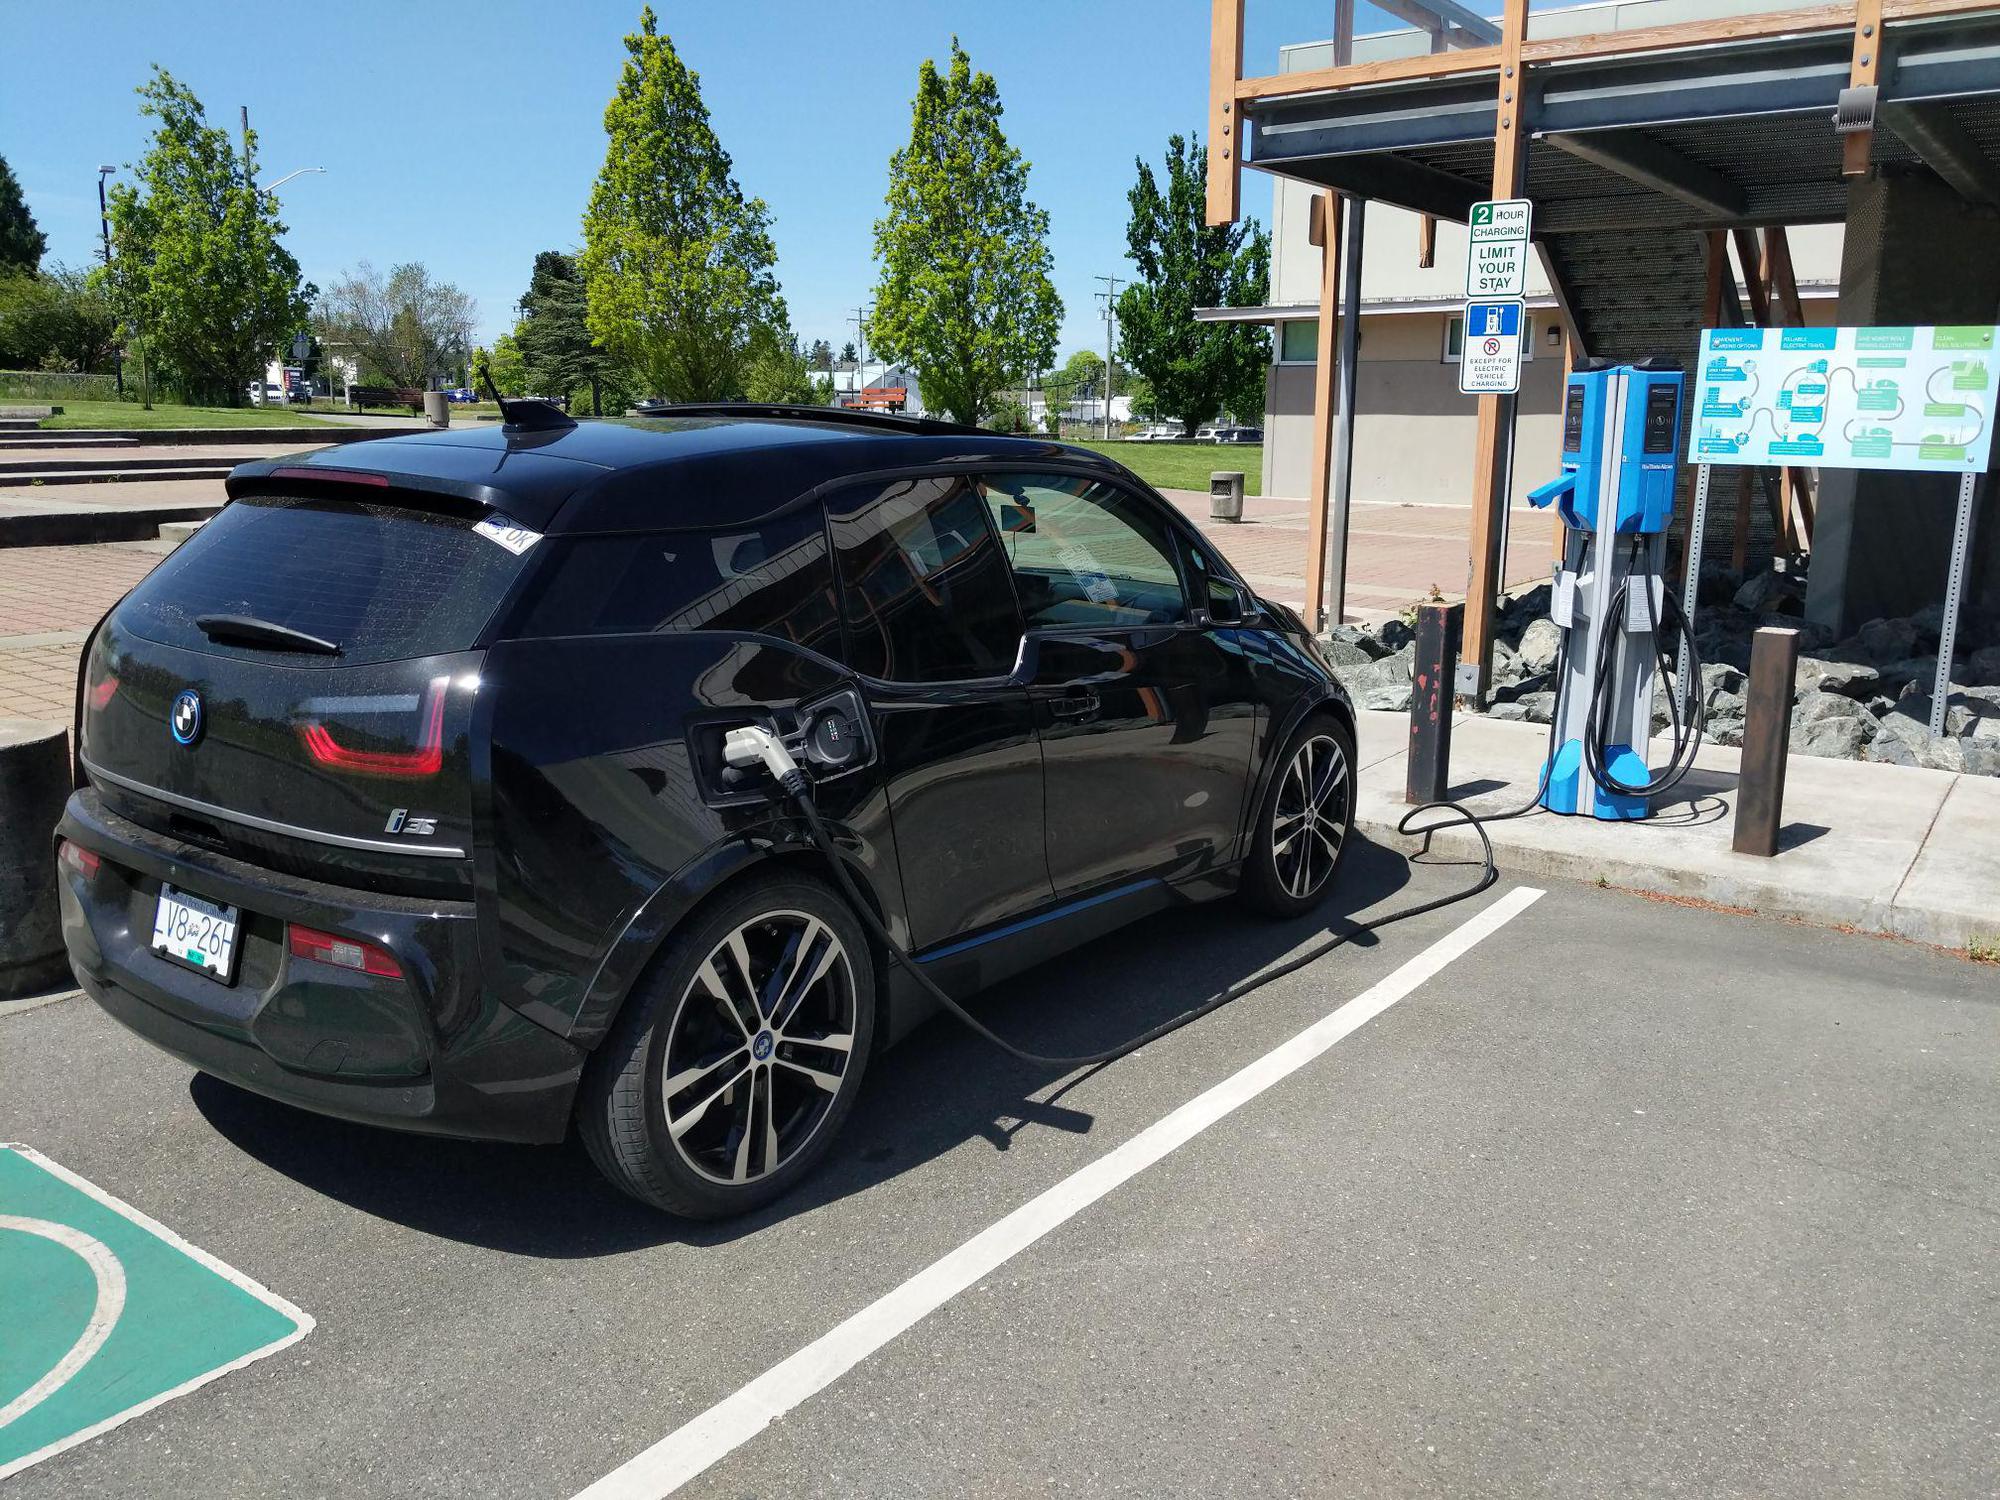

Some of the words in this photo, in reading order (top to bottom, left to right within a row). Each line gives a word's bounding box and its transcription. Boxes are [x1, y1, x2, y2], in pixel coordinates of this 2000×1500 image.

[1477, 206, 1489, 223] 2
[1496, 211, 1524, 220] HOUR
[1473, 226, 1525, 237] CHARGING
[1480, 247, 1516, 259] LIMIT
[1478, 262, 1515, 274] YOUR
[1479, 277, 1511, 289] STAY
[506, 529, 533, 547] OK
